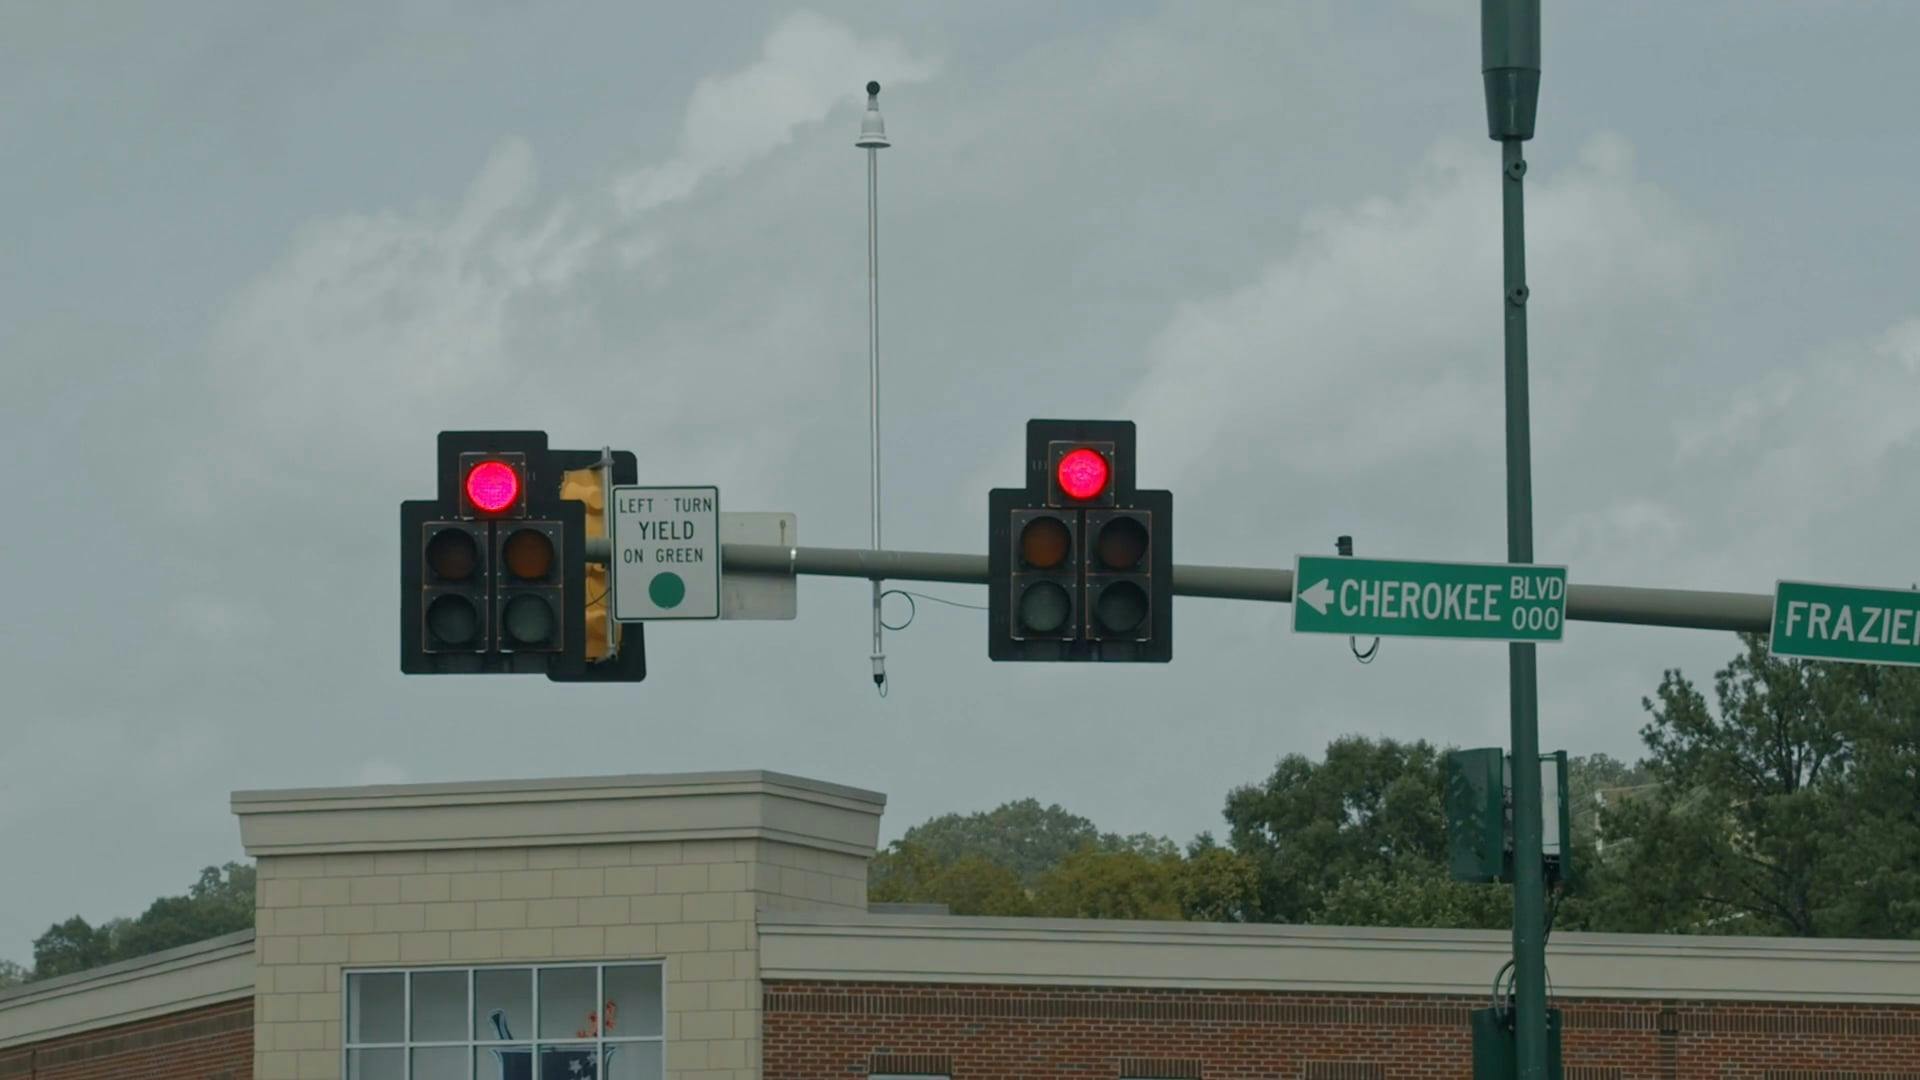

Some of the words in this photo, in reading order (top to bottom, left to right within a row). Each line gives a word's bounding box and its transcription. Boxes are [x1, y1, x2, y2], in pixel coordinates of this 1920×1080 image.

[619, 498, 654, 513] LEFT
[673, 498, 712, 512] TURN
[639, 520, 694, 540] YIELD
[624, 548, 644, 563] ON
[656, 548, 703, 563] GREEN
[1340, 578, 1502, 622] CHEROKEE
[1510, 575, 1563, 600] BLVD
[1785, 600, 1920, 646] FRAZIE
